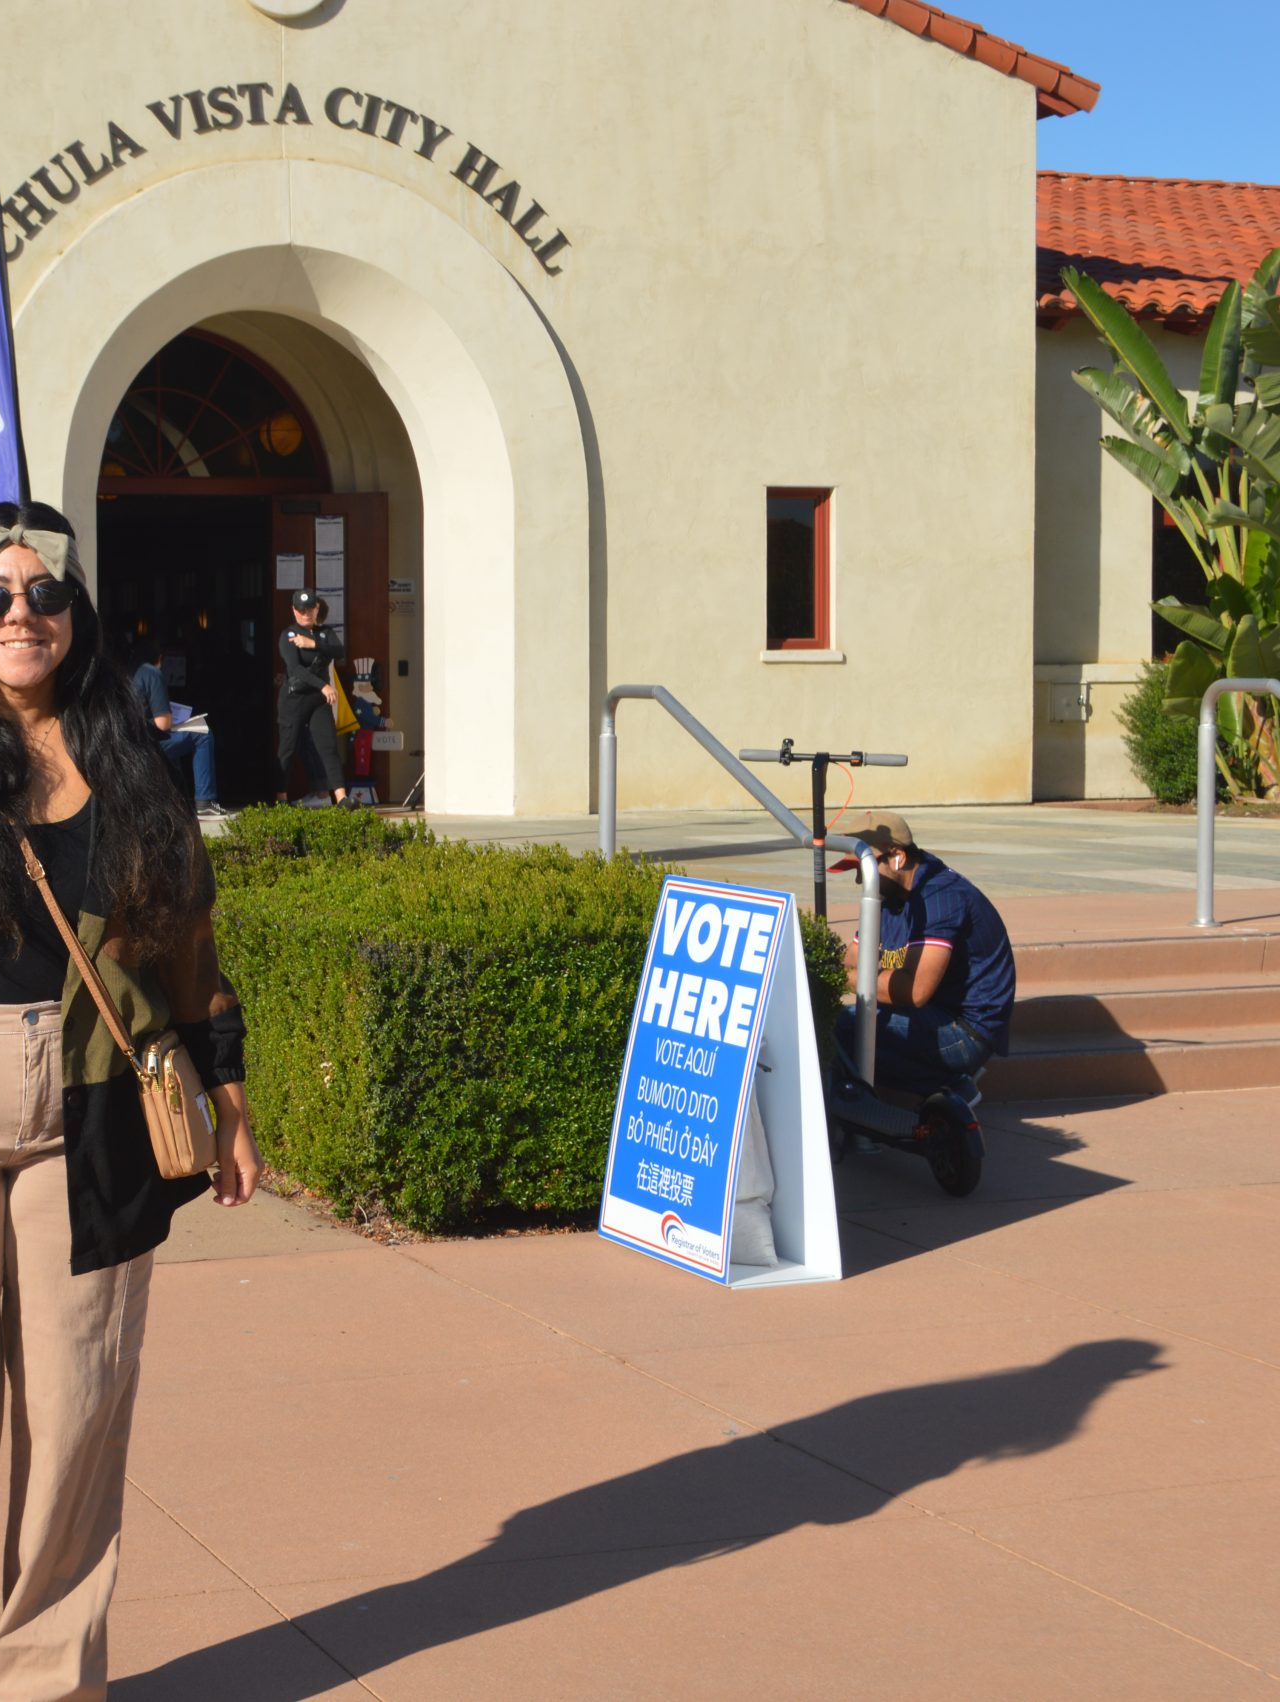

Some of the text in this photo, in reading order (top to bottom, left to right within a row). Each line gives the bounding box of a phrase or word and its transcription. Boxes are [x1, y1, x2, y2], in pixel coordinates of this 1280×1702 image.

[145, 81, 314, 142] VISTA
[324, 86, 455, 163] CITY
[449, 141, 573, 277] HALL
[662, 897, 775, 975] VOTE
[642, 966, 758, 1049] HERE
[655, 1037, 719, 1078] VOTE AQUÍ
[637, 1075, 719, 1123] BUMOTO DITO
[626, 1110, 644, 1144] BỎ
[644, 1120, 679, 1156] PHIẾU
[691, 1133, 718, 1168] ĐÂY
[671, 1234, 695, 1249] Registrar
[701, 1245, 720, 1260] Voters
